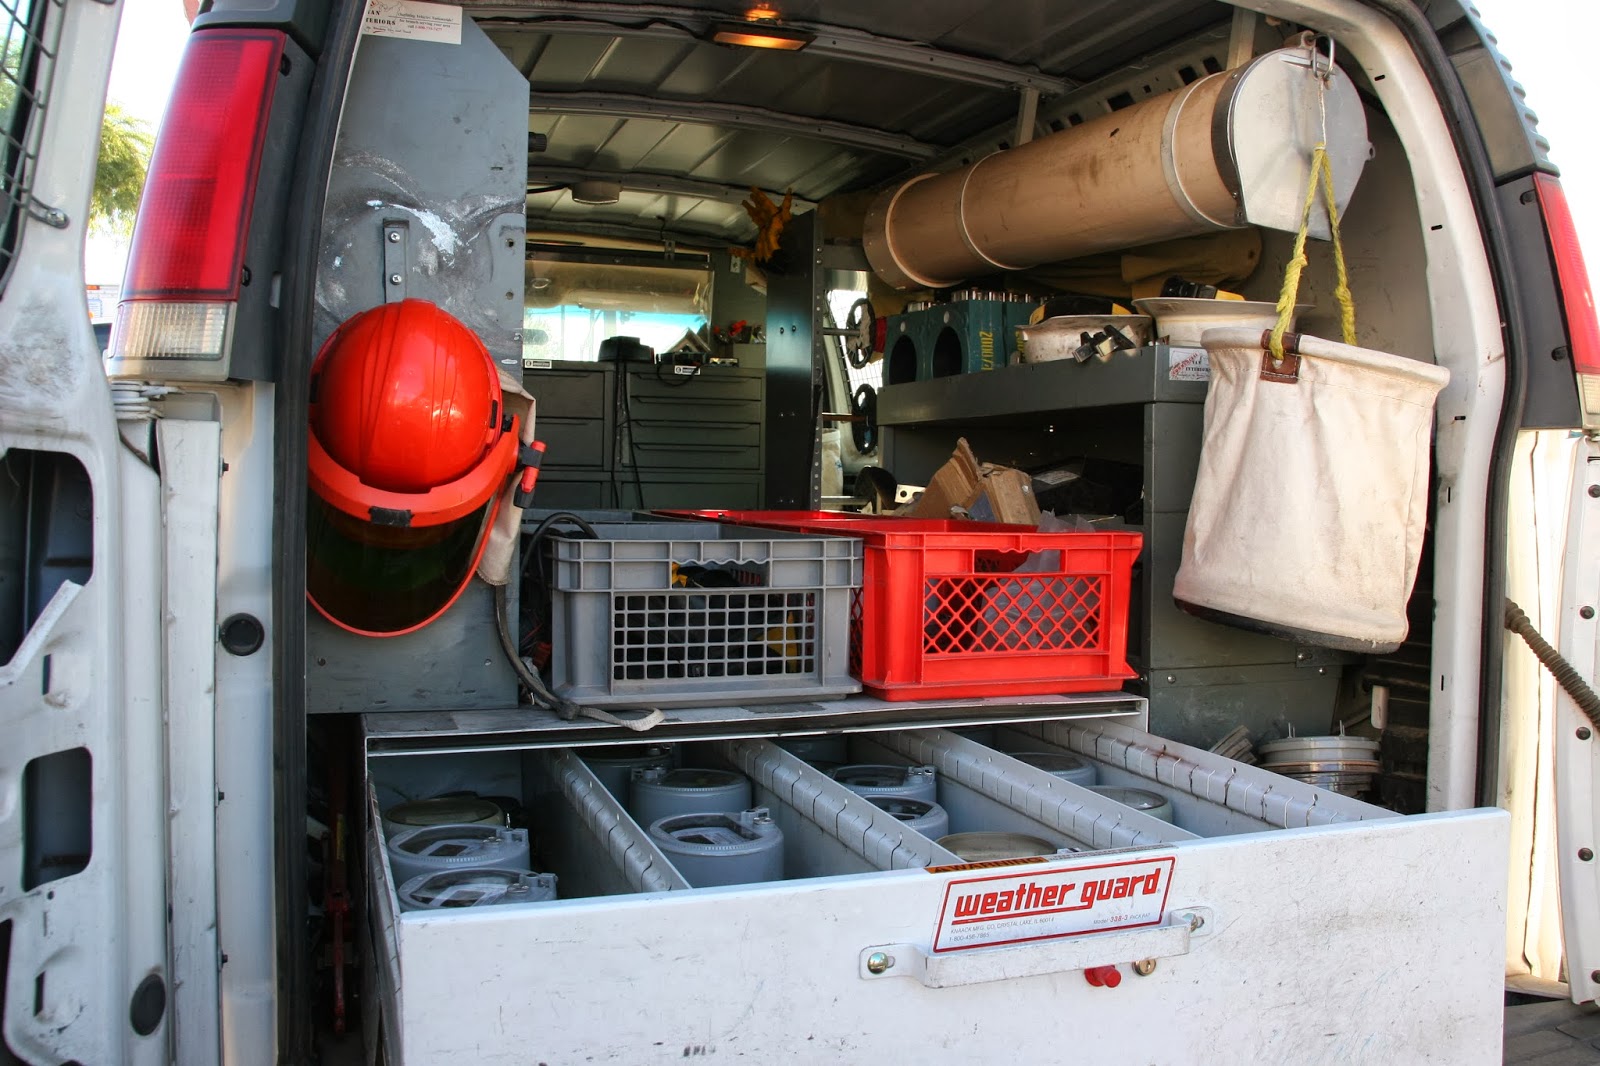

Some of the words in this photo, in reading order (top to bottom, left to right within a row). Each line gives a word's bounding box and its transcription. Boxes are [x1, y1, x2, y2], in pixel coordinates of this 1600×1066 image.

[365, 17, 396, 26] TERIORS
[949, 857, 1043, 870] WARNING
[953, 882, 1076, 918] weather
[1079, 867, 1162, 910] guard
[1109, 914, 1129, 923] 338-3
[996, 920, 1019, 930] CRYSTAL
